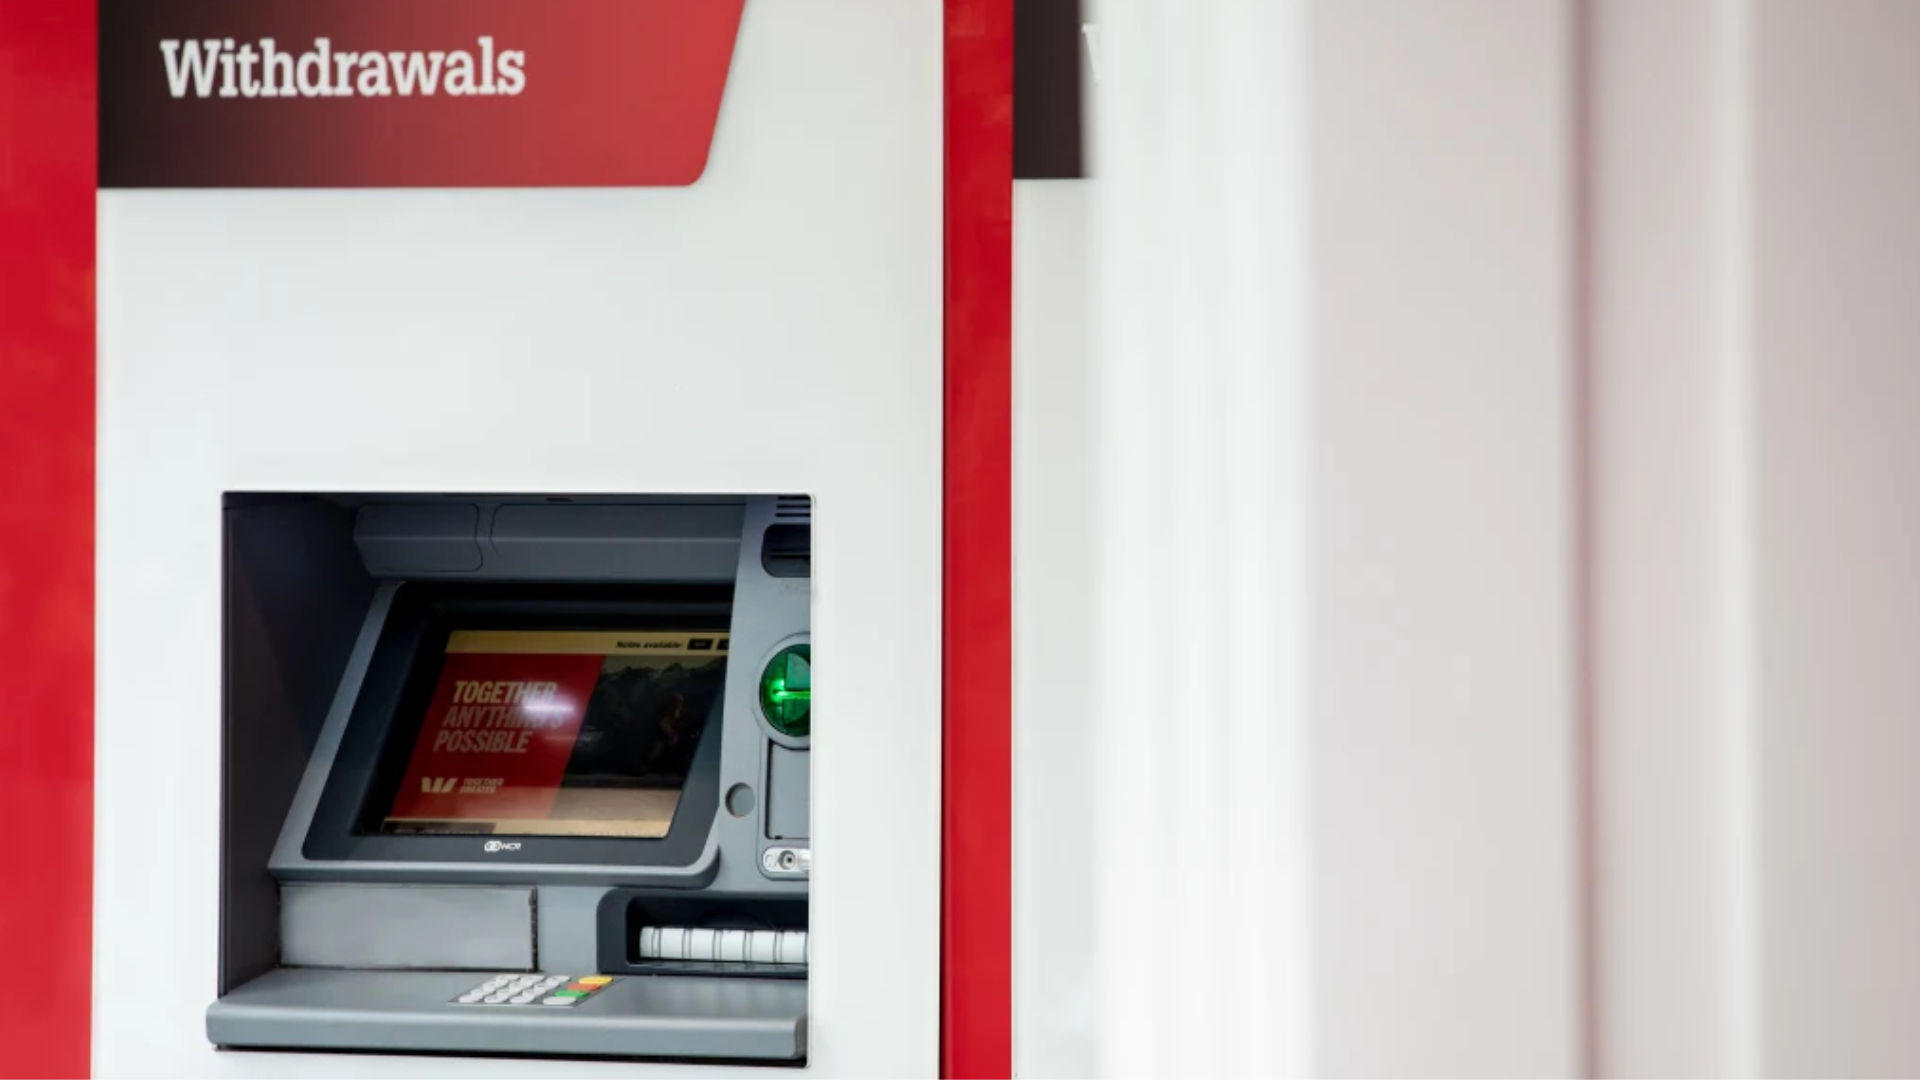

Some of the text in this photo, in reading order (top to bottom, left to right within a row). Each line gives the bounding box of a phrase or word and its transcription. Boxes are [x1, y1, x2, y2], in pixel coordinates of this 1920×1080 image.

[160, 35, 526, 97] Withdrawals
[453, 681, 557, 704] TOGETHER
[433, 730, 532, 753] POSSIBLE
